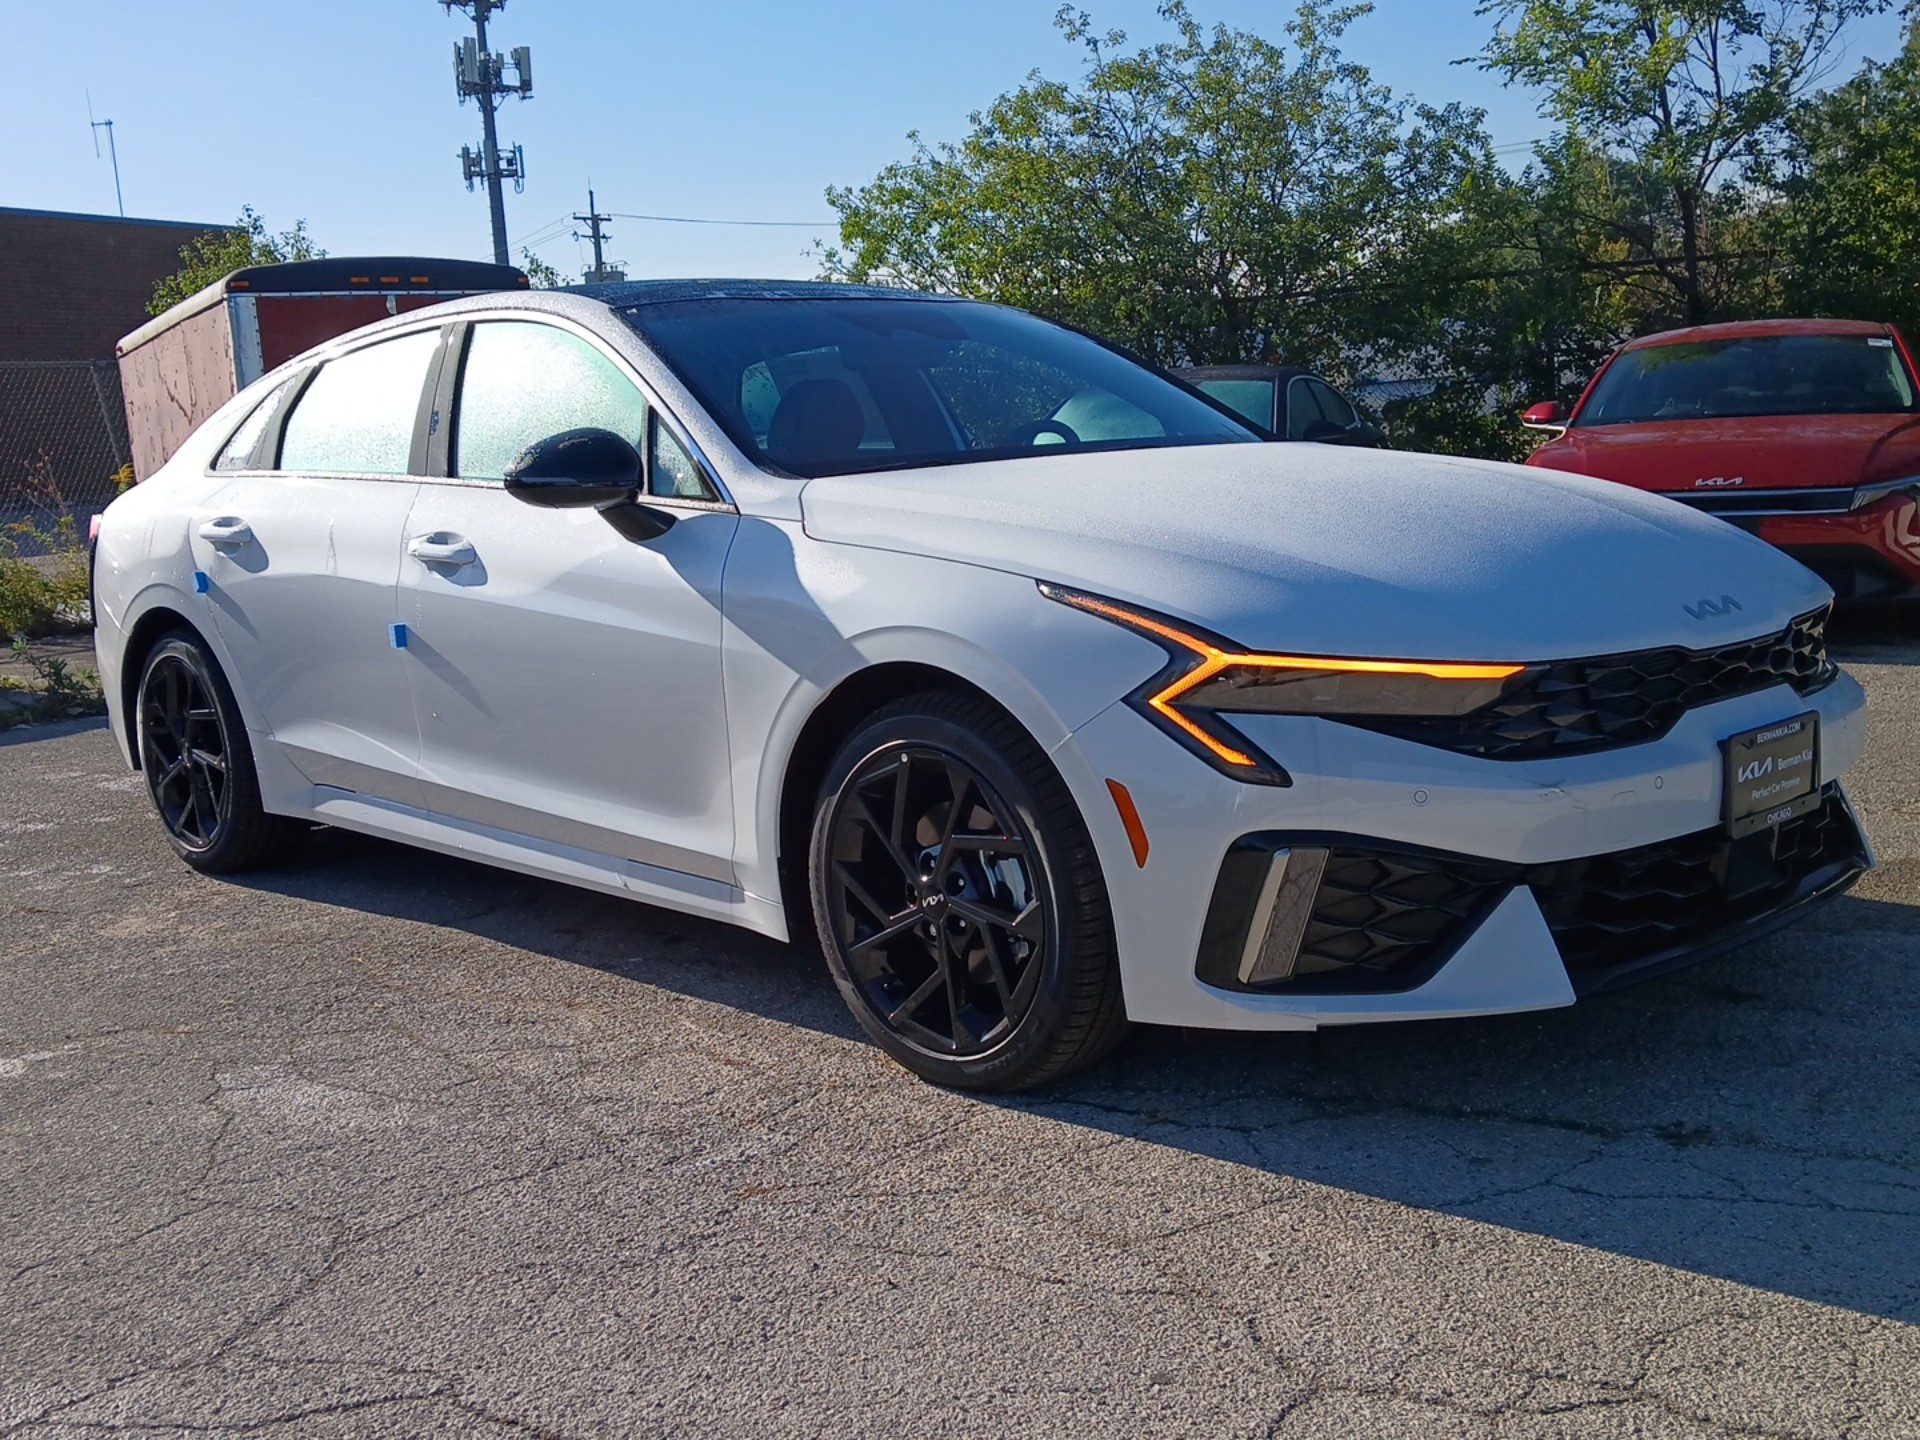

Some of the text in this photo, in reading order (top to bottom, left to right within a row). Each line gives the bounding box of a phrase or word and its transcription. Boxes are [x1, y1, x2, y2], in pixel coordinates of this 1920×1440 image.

[1756, 721, 1801, 744] BERMANKIA.COM
[1738, 756, 1773, 783] KIA
[1778, 754, 1801, 770] Berman
[1751, 784, 1771, 800] Perfect
[1771, 782, 1781, 793] Car
[1767, 807, 1792, 824] CHICAGO
